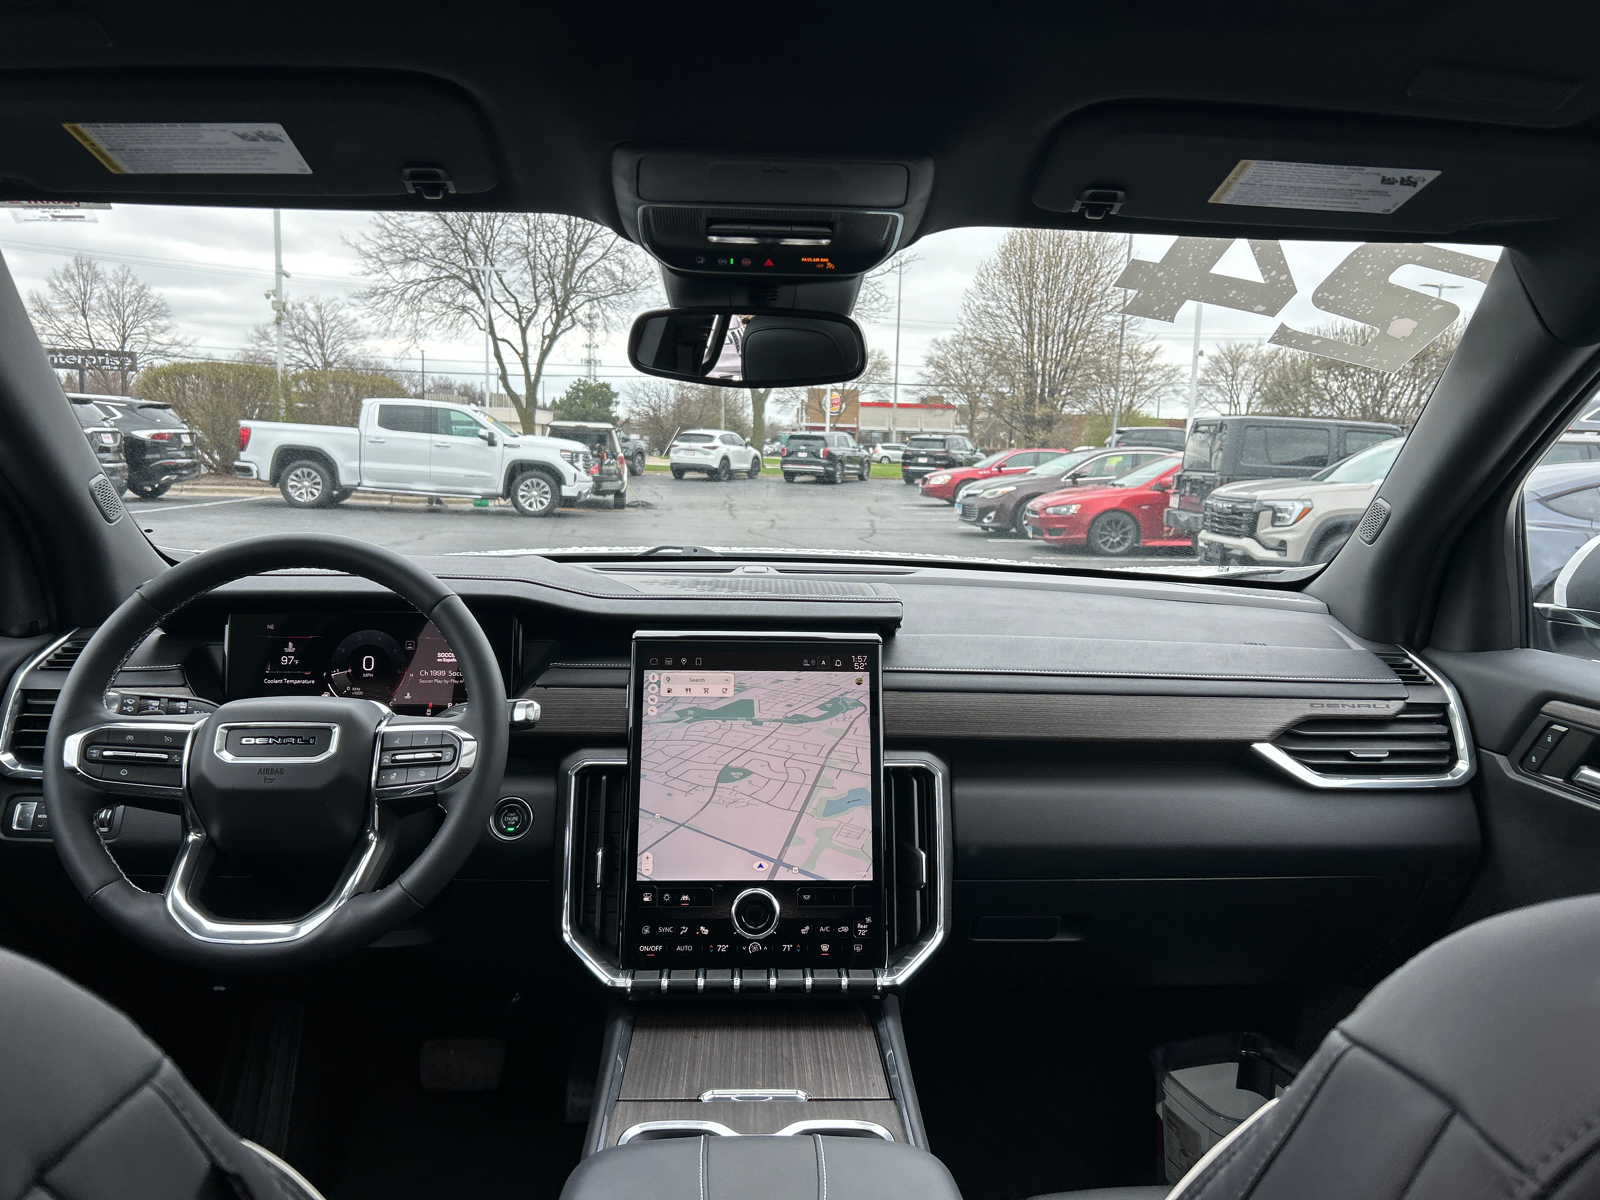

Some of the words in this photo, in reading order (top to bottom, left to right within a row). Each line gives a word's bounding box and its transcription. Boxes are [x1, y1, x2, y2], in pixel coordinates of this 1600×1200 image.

[49, 353, 132, 367] nterprise
[362, 656, 374, 671] 0
[852, 655, 868, 663] 1:57
[240, 736, 315, 746] DENALI
[257, 767, 284, 776] AIRBAG
